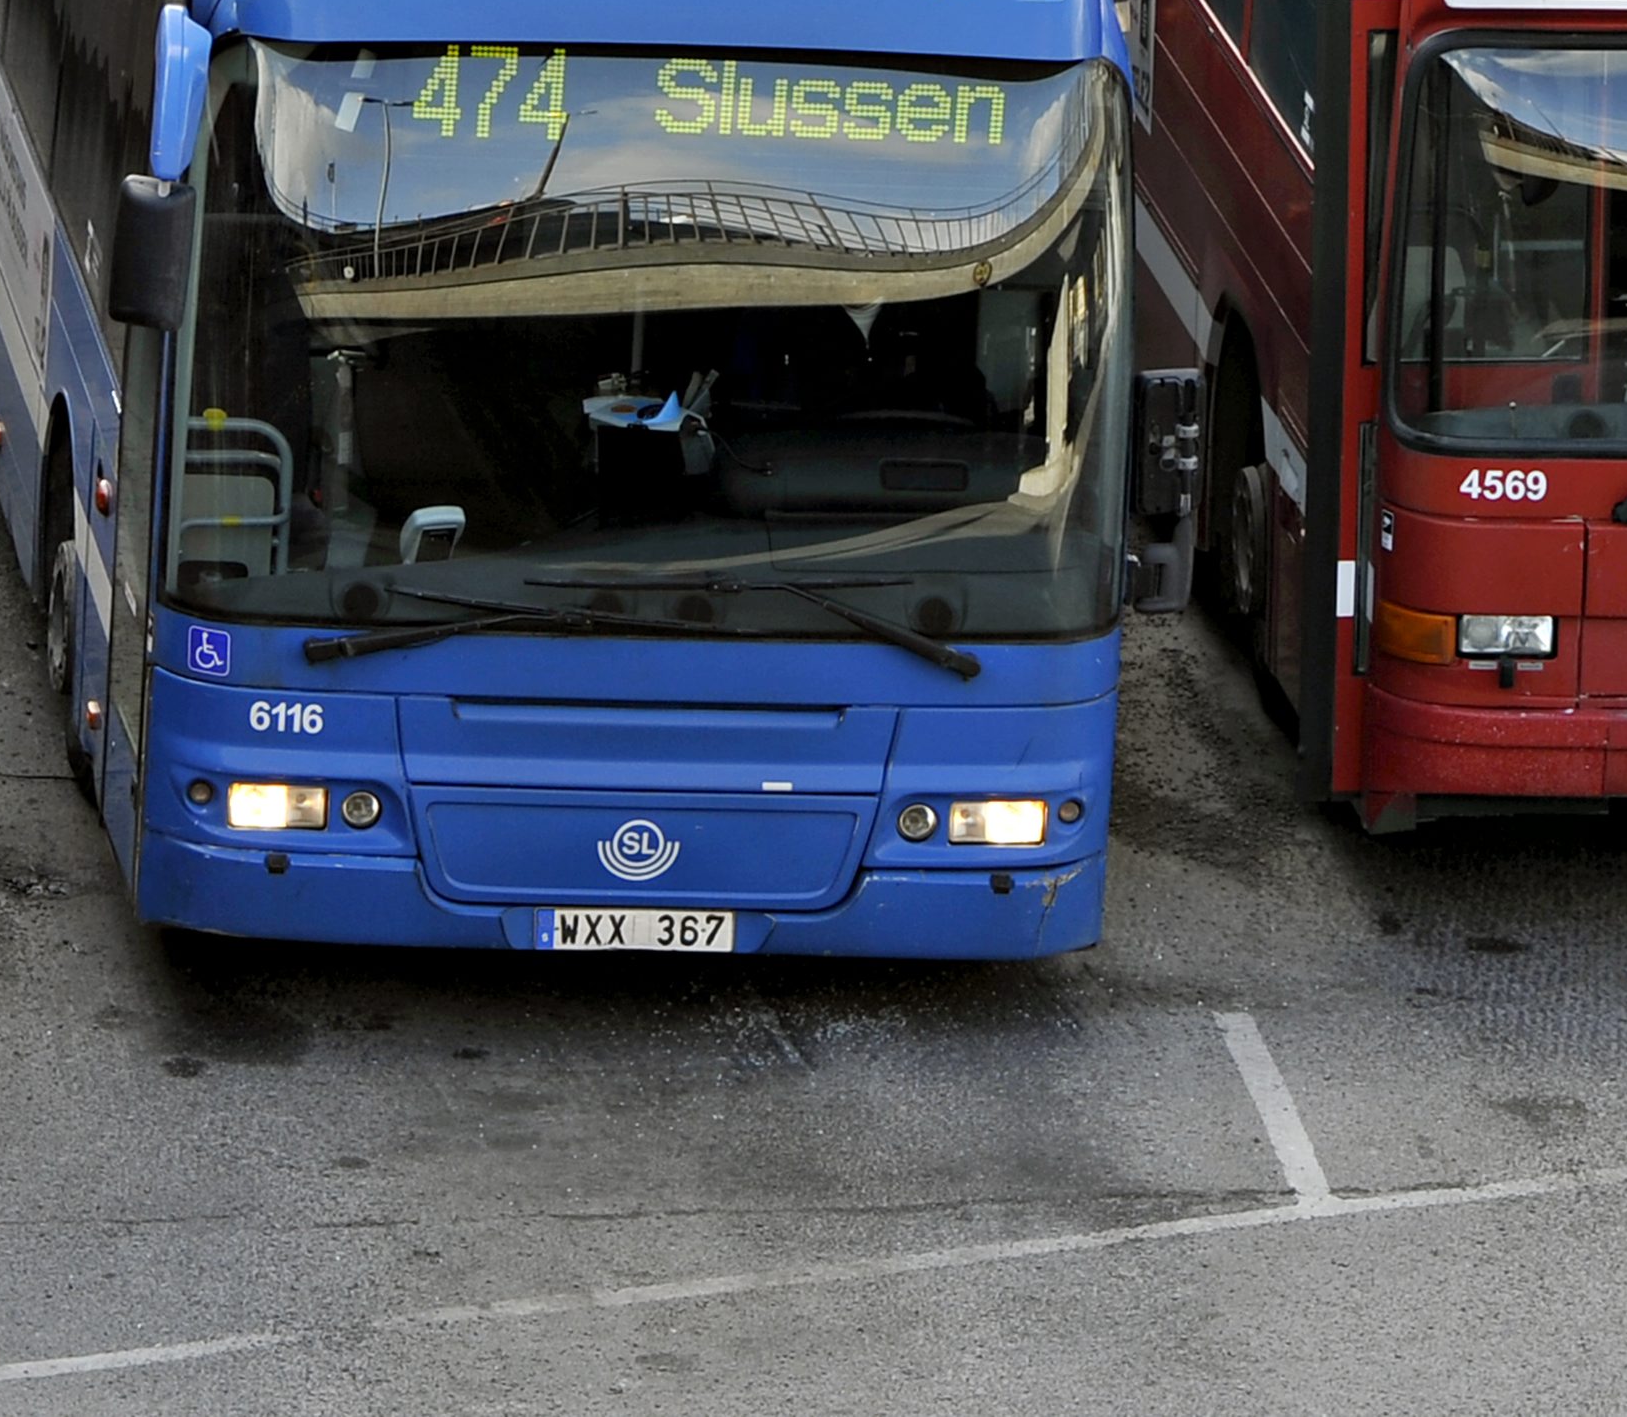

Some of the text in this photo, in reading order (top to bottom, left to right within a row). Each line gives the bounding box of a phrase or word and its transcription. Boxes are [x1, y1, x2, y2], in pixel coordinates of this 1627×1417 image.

[413, 44, 1005, 145] 474 Slussen
[1459, 468, 1548, 501] 4569
[249, 700, 324, 735] 6116
[622, 831, 656, 855] SL
[560, 914, 726, 946] WXX 367
